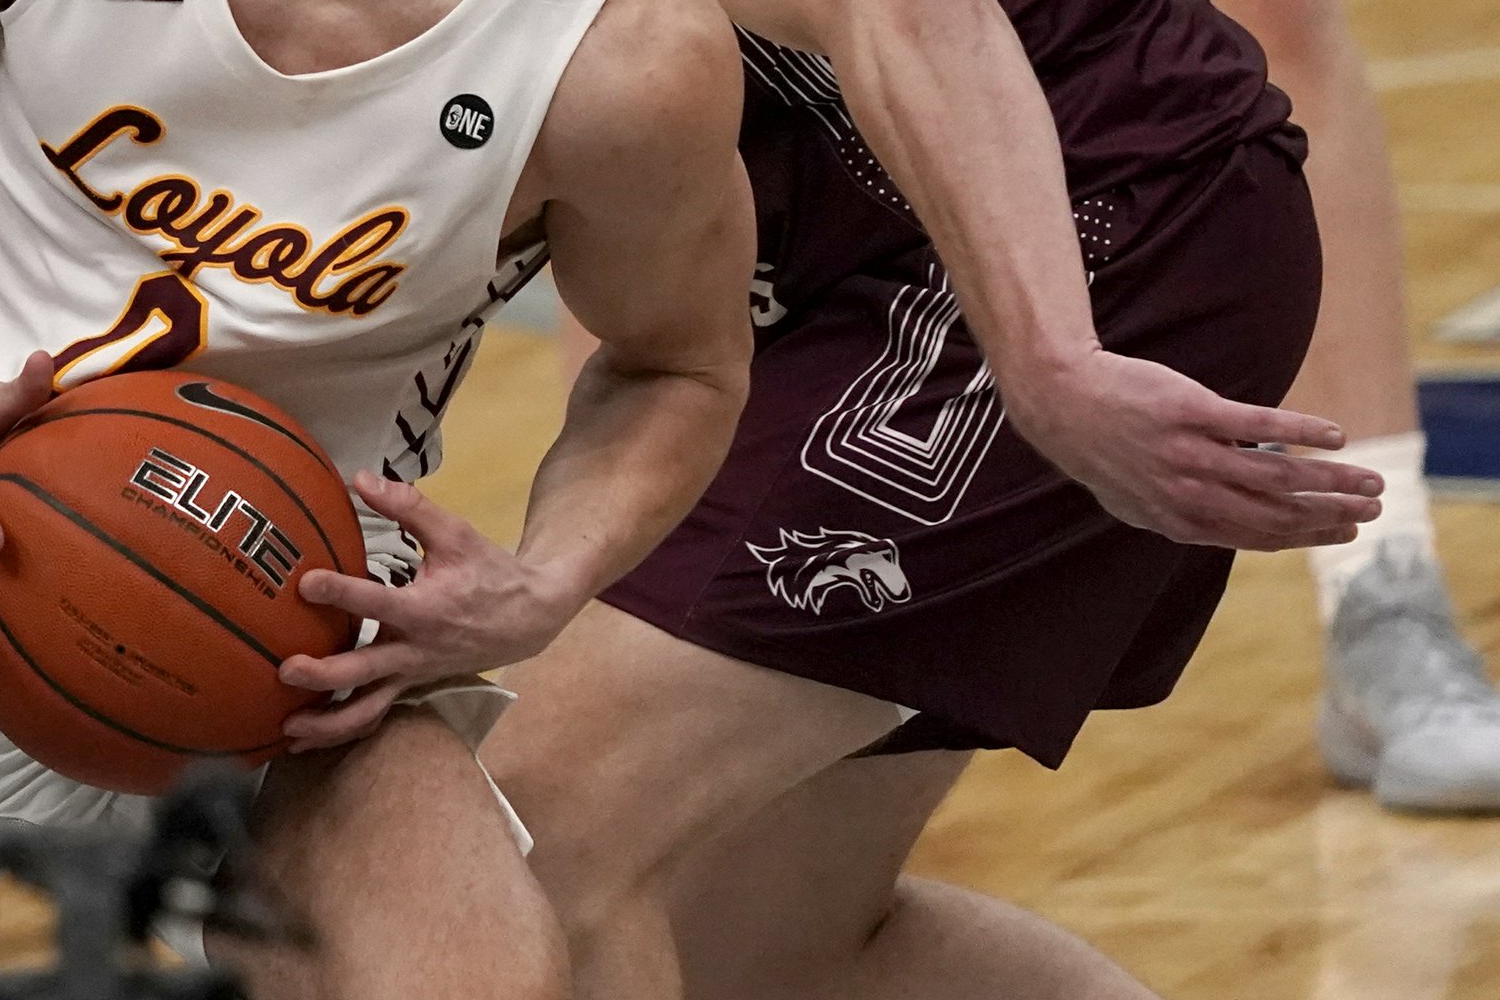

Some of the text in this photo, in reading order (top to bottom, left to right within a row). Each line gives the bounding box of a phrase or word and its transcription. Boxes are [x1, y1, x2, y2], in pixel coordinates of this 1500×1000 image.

[40, 104, 410, 318] Loyola
[120, 486, 277, 600] CHAMPIONSHIP
[130, 447, 302, 589] ELITE
